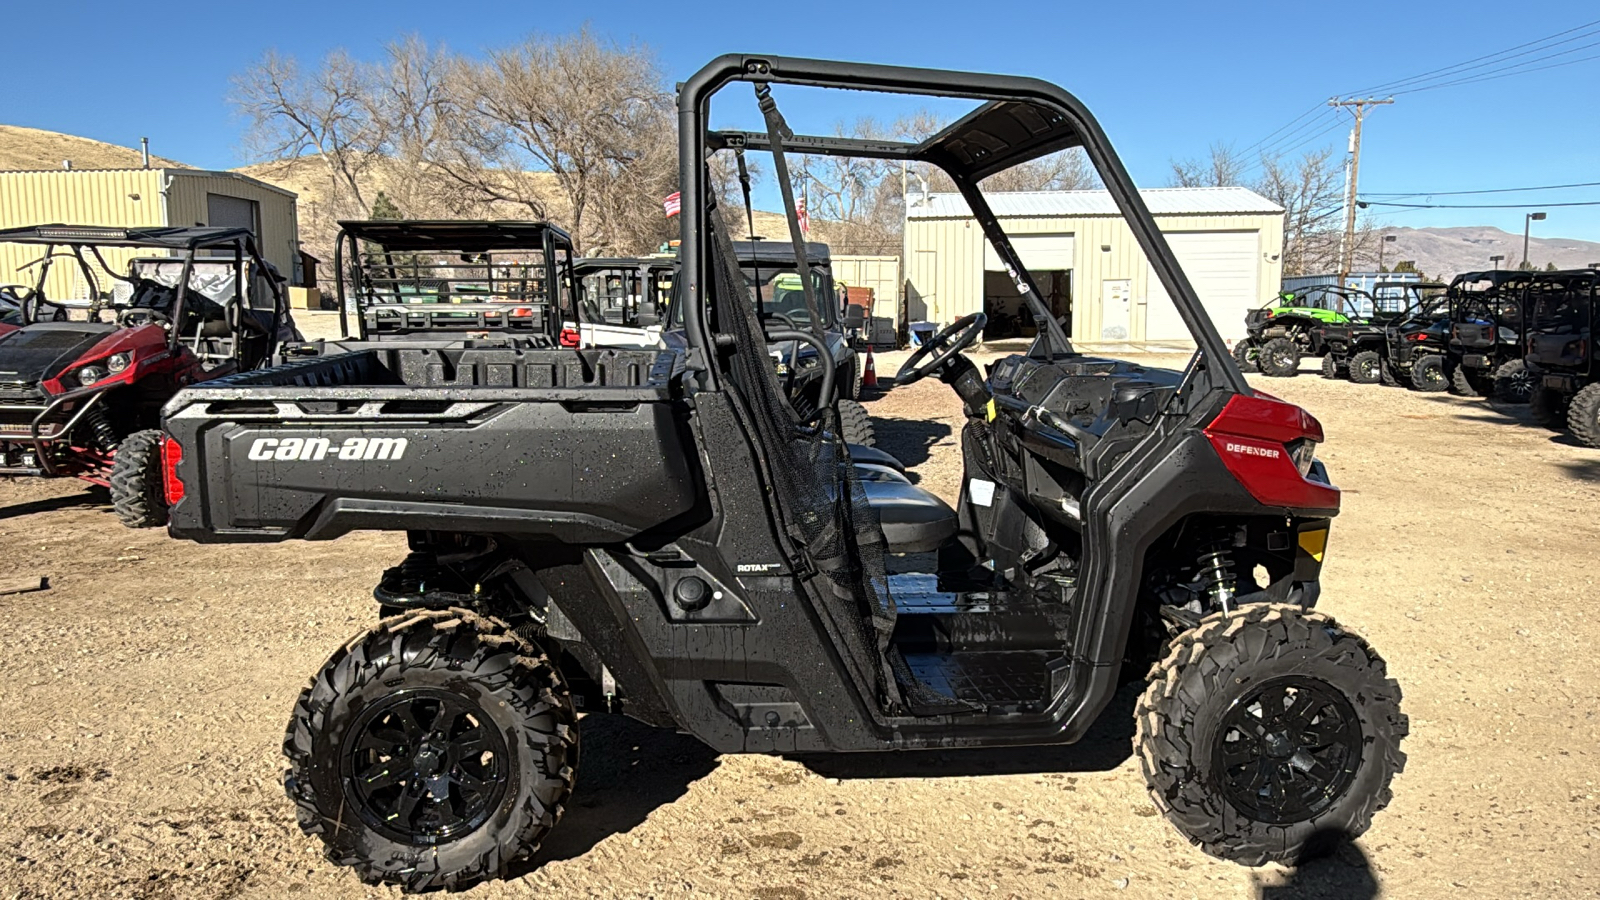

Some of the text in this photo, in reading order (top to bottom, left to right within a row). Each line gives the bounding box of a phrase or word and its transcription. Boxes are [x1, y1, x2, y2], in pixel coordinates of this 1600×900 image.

[248, 437, 408, 461] can-am
[1226, 443, 1280, 459] DEFENDER
[737, 563, 768, 572] ROTAX
